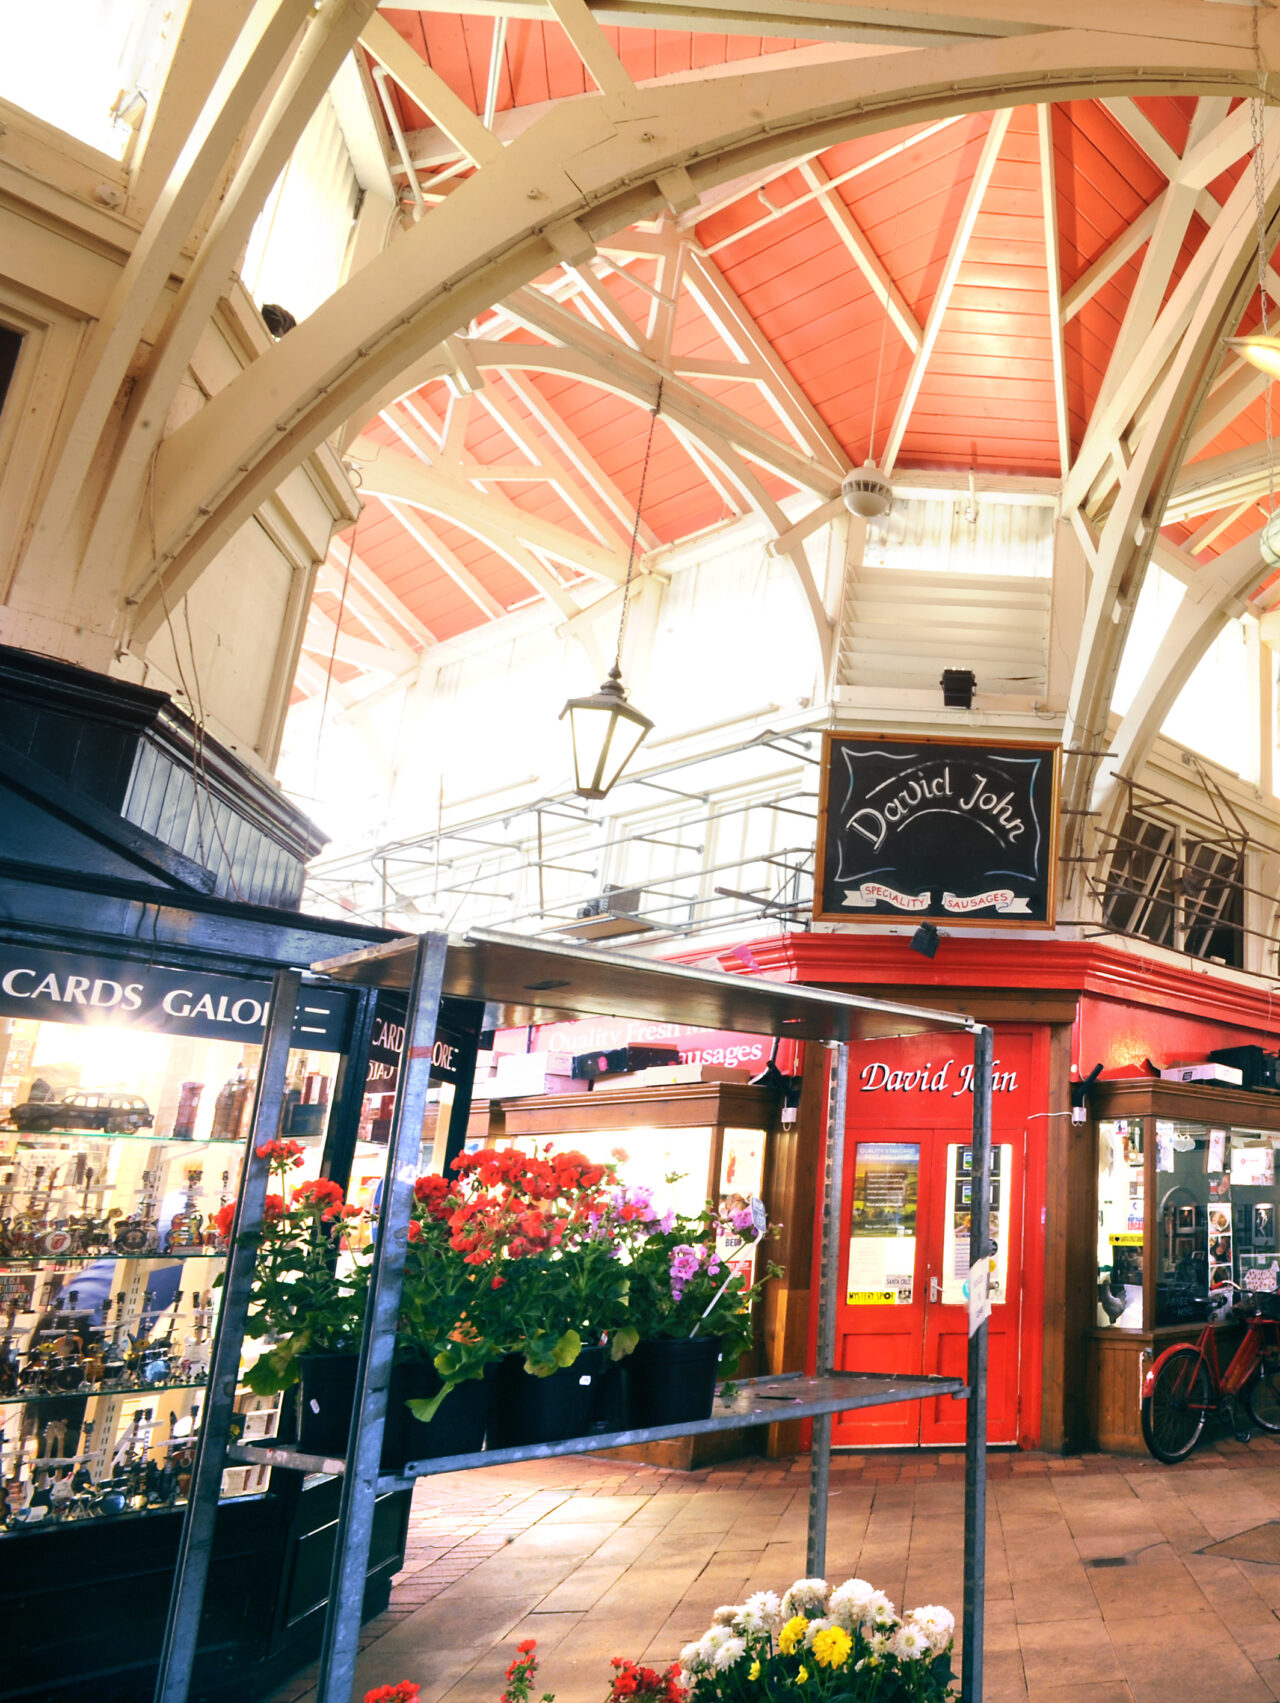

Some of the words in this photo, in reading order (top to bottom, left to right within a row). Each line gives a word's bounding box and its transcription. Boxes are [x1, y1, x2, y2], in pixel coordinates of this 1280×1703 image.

[846, 766, 953, 853] David
[960, 773, 1025, 844] John
[865, 885, 925, 908] SPECIALITY
[946, 892, 1008, 909] SAUSAGES
[2, 968, 144, 1011] CARDS
[550, 1029, 619, 1051] Quality
[626, 1022, 680, 1042] Fresh
[860, 1059, 954, 1092] David
